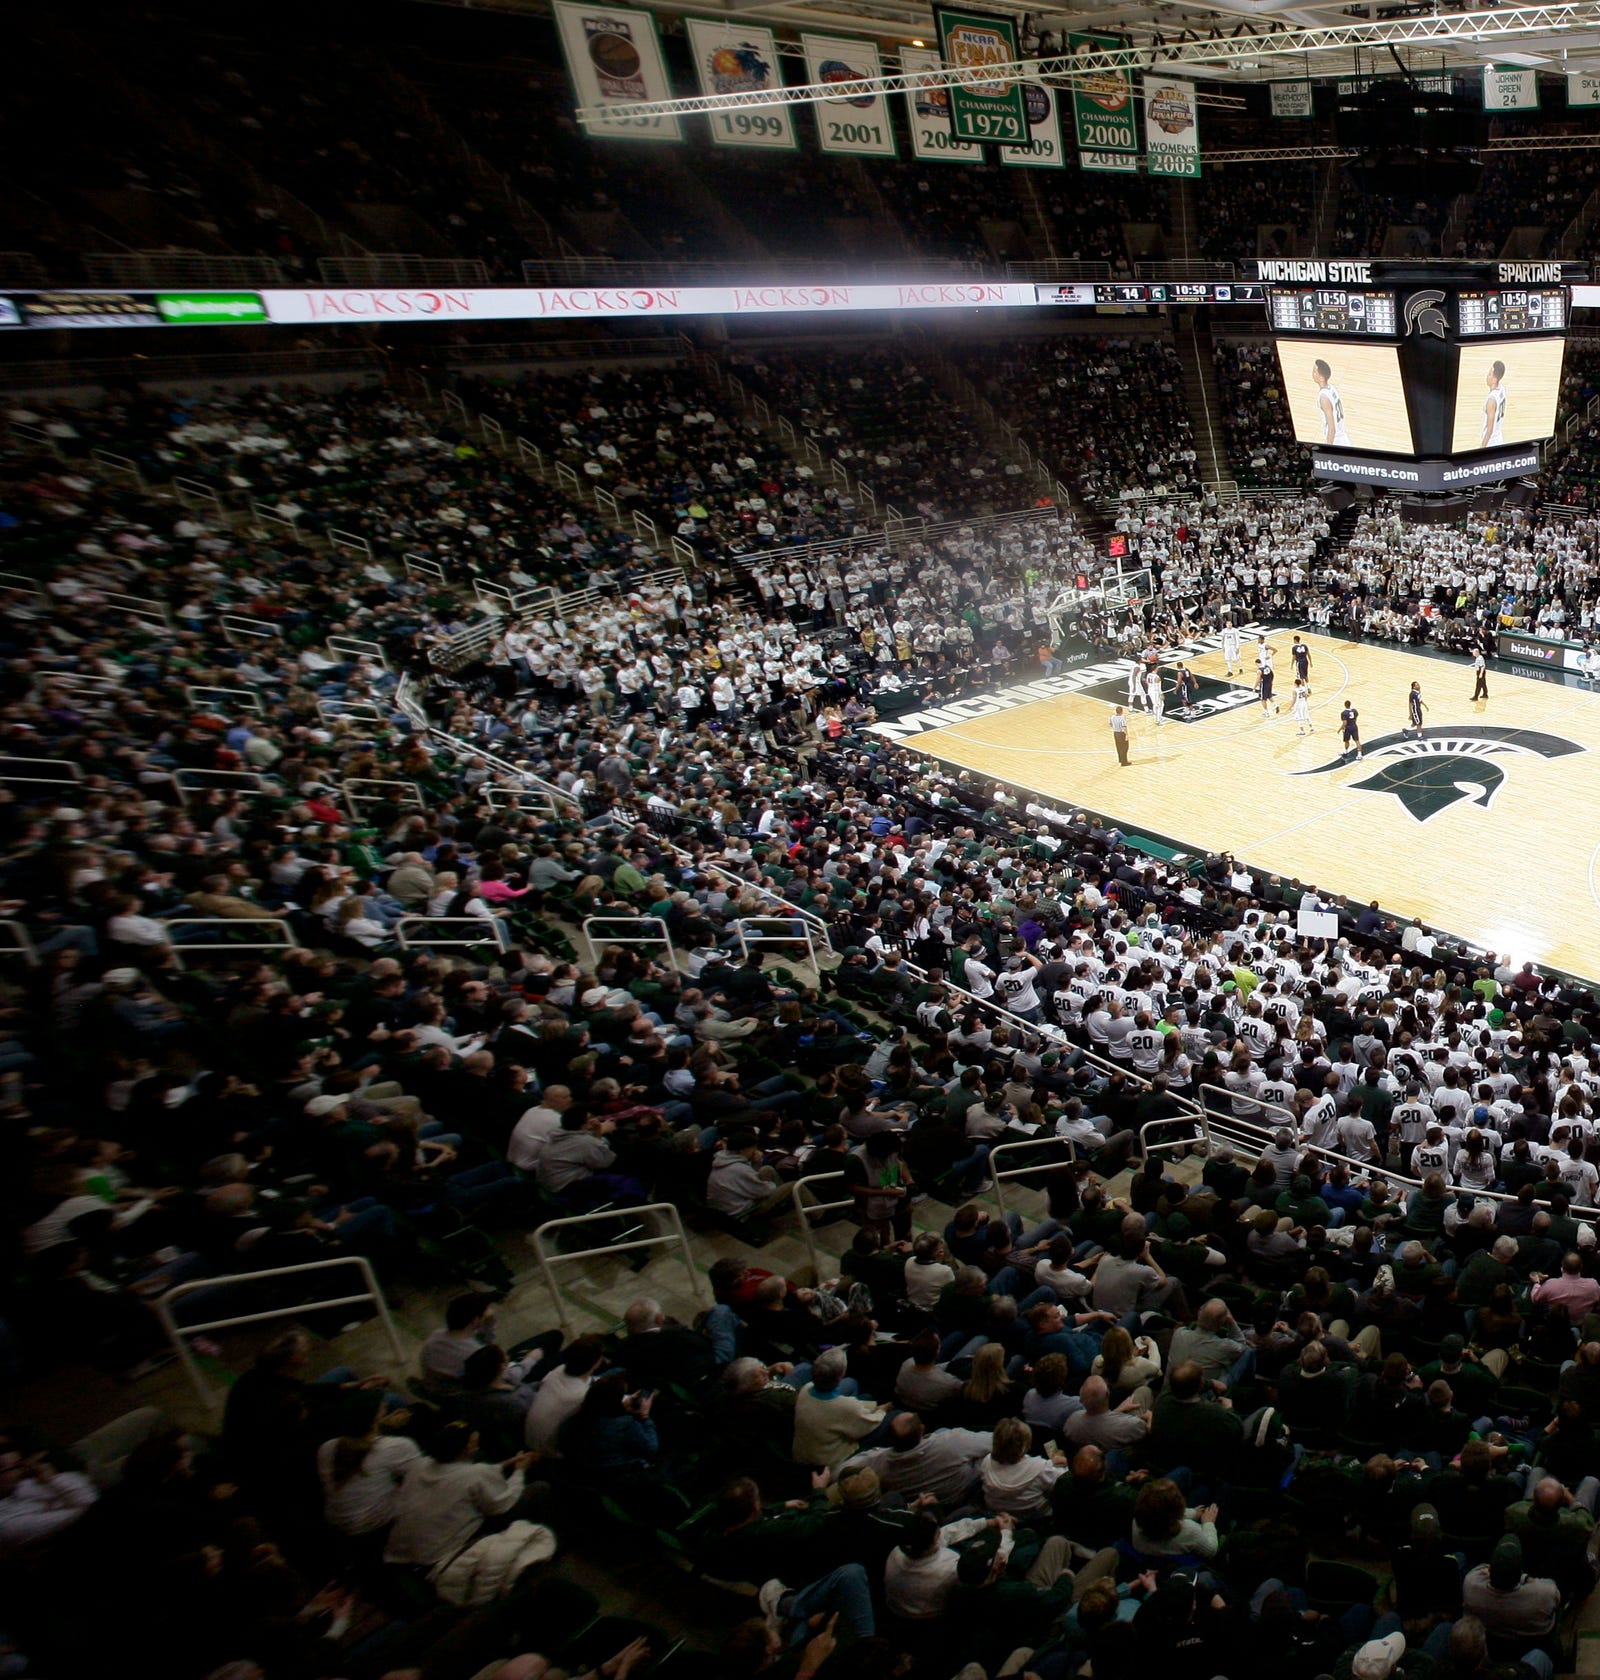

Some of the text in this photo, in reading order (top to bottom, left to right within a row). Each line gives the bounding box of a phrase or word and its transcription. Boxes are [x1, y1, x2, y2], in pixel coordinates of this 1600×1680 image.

[963, 33, 995, 45] NCAA
[1496, 74, 1522, 84] JOHNNY
[1498, 85, 1521, 94] GREEN
[1591, 90, 1599, 101] 4
[959, 100, 1017, 113] CHAMPIONS
[1503, 95, 1517, 106] 24
[720, 113, 782, 137] 1999
[1081, 112, 1129, 124] CHAMPIONS
[963, 113, 1019, 138] 1979
[828, 122, 881, 144] 2001
[1084, 124, 1131, 147] 2000
[1150, 142, 1196, 154] WOMEN'S
[1153, 155, 1195, 174] 2005
[1257, 260, 1373, 283] MICHIGAN STATE
[1499, 263, 1561, 283] SPARTANS
[897, 286, 1004, 304] JACKSON
[1122, 288, 1138, 299] 14
[1175, 285, 1206, 295] 10:50
[1244, 288, 1253, 298] 7
[1318, 292, 1346, 305] 10:50
[305, 291, 471, 318] JACKSON
[539, 289, 678, 313] JACKSON
[733, 288, 848, 311] JACKSON
[1502, 293, 1527, 306] 10:50
[1304, 317, 1315, 328] 14
[1354, 319, 1361, 330] 7
[1489, 319, 1499, 330] 14
[1532, 317, 1538, 328] 7
[1313, 458, 1419, 482] auto-owners.com
[1443, 455, 1537, 481] auto-owners.com
[1510, 642, 1545, 658] bizhub
[1066, 651, 1089, 664] xfinity
[864, 655, 1143, 741] MICHIGAN
[1143, 931, 1153, 942] 20
[1274, 963, 1285, 976] 20
[1355, 970, 1369, 980] 20
[1004, 979, 1024, 992] 20
[1367, 989, 1383, 1001] 20
[1055, 997, 1071, 1011] 20
[1125, 996, 1138, 1011] 20
[1271, 1003, 1286, 1017] 20
[1242, 1022, 1258, 1038] 20
[1132, 1035, 1153, 1050] 20
[1473, 1068, 1488, 1080] 20
[1264, 1089, 1284, 1102] 20
[1318, 1102, 1335, 1123] 20
[1400, 1110, 1421, 1124] 20
[1420, 1153, 1443, 1168] 20
